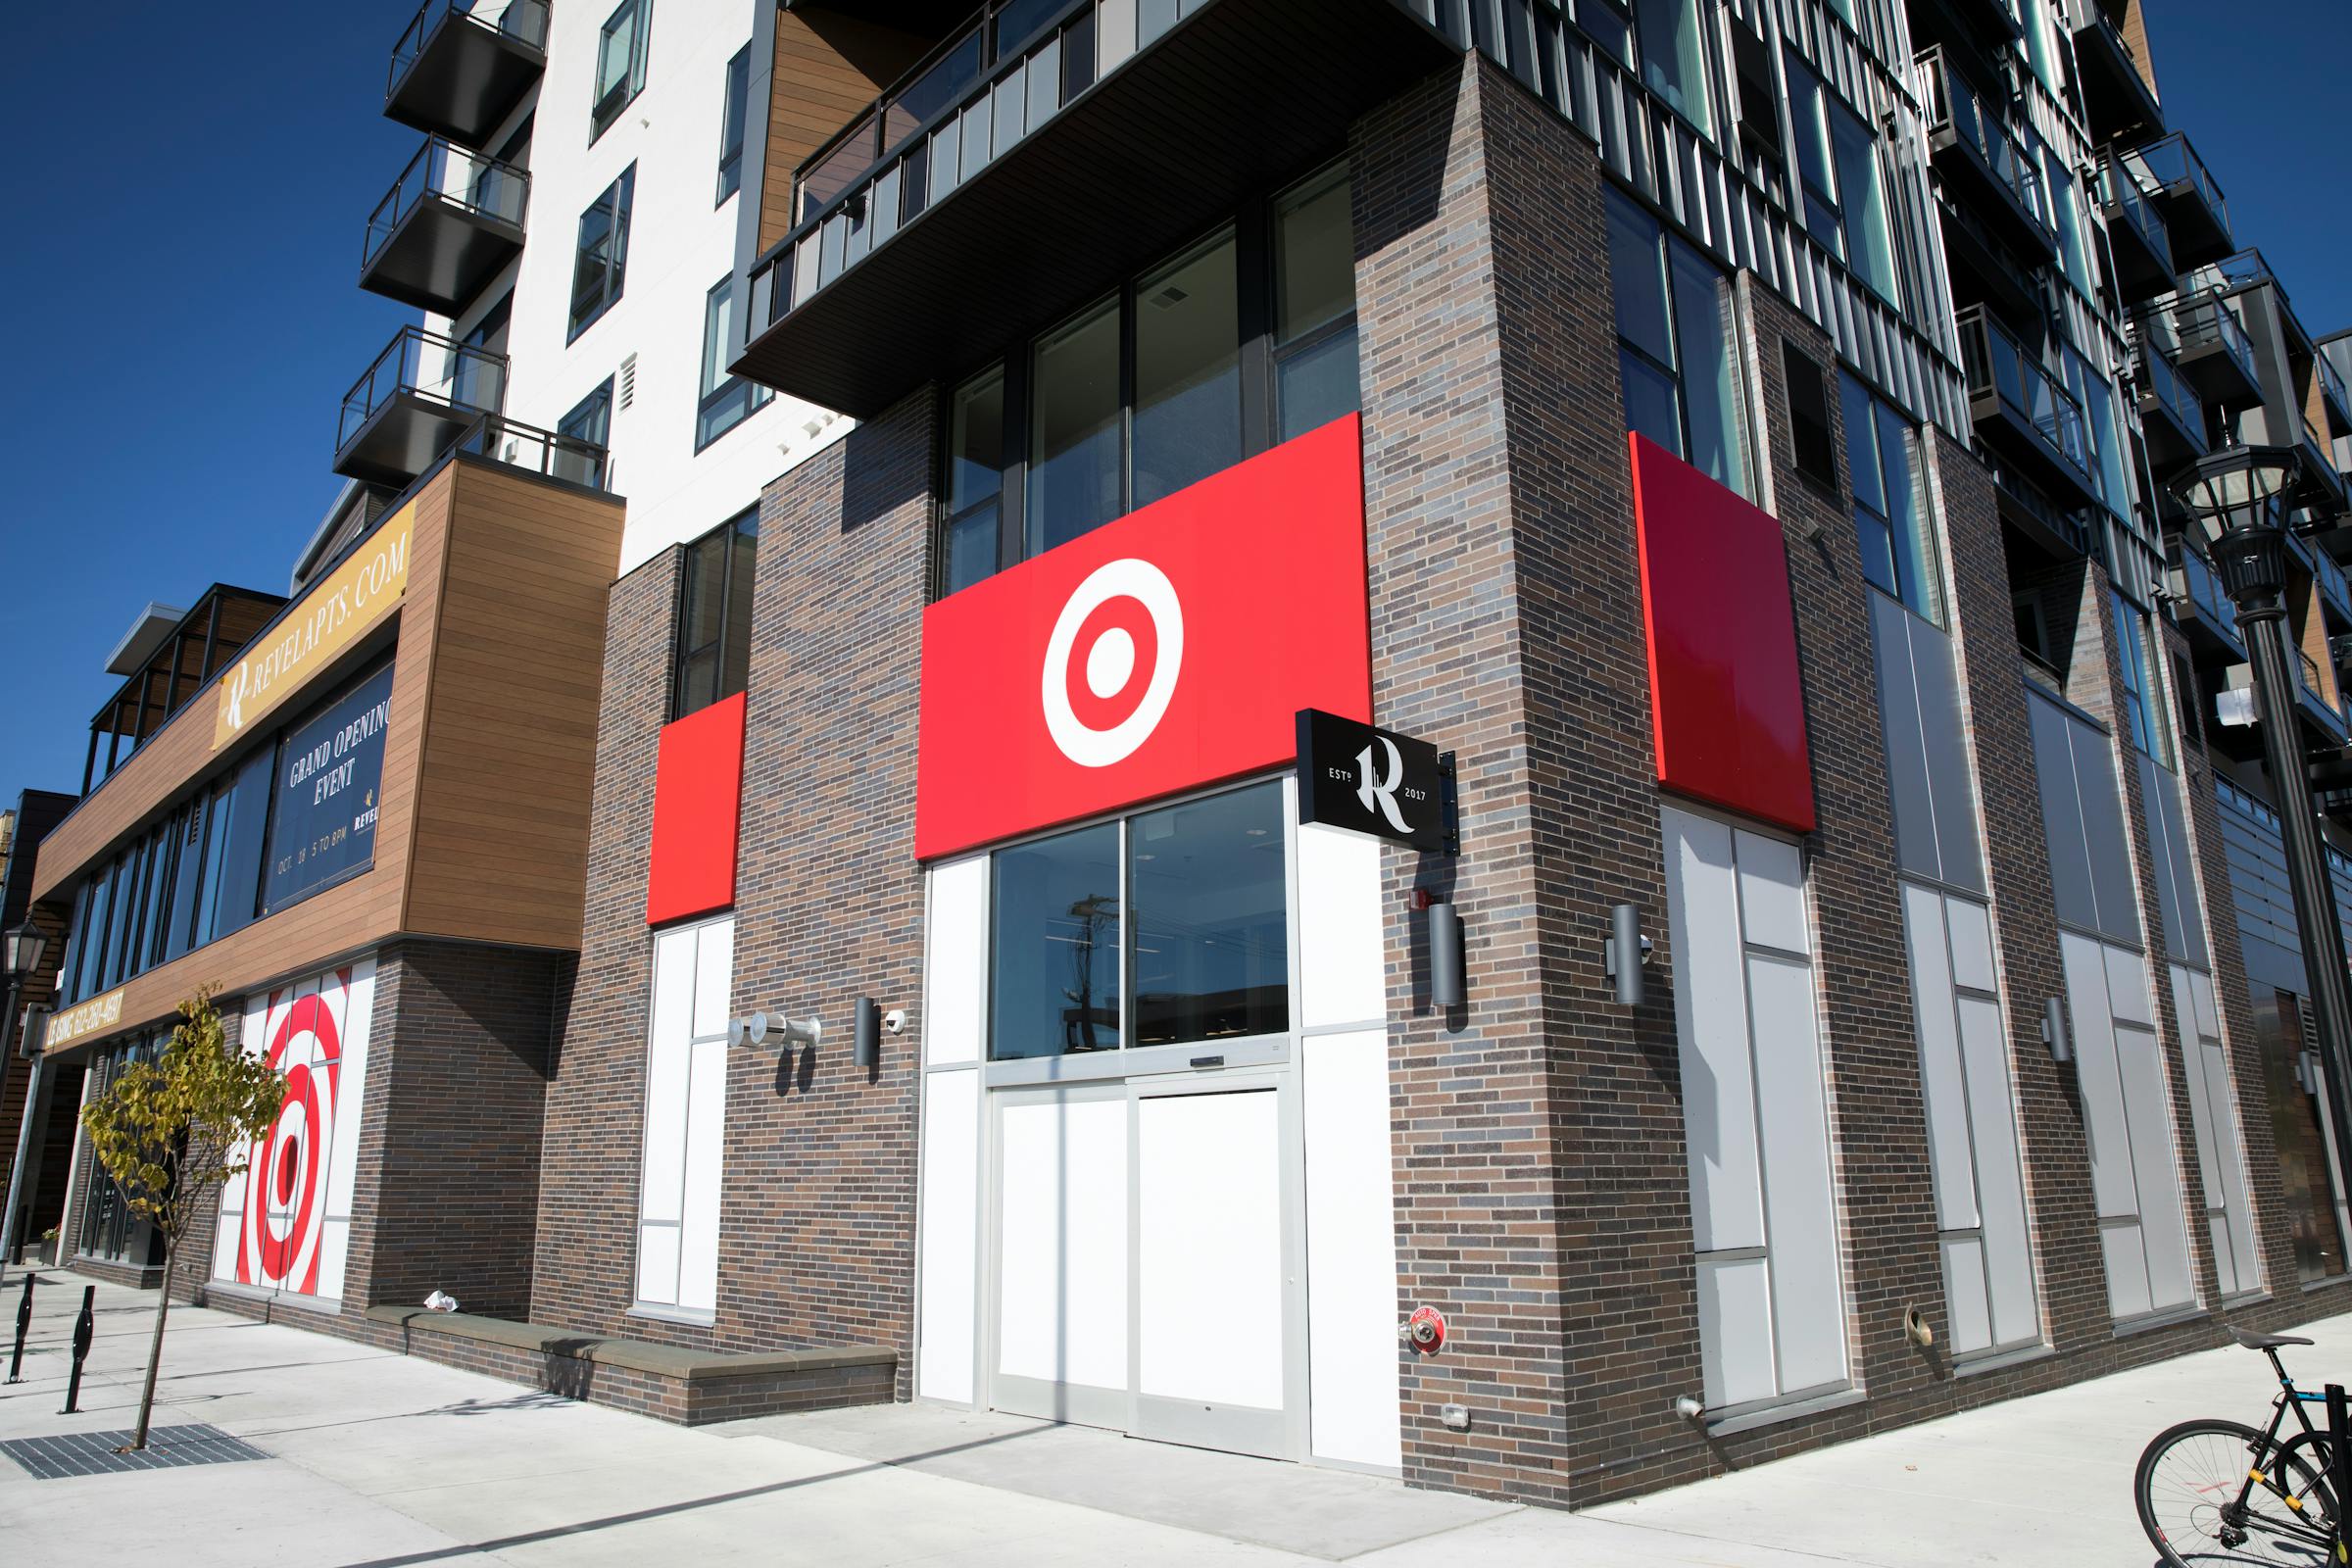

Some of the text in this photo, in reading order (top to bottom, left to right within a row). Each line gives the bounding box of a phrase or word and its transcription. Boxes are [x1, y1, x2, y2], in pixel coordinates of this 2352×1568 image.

[251, 532, 407, 699] REVELAPTS.COM
[290, 741, 330, 788] GRAND
[314, 758, 355, 806] EVENT
[1354, 735, 1416, 834] R
[1404, 787, 1426, 802] 2017
[312, 842, 318, 857] 5
[319, 835, 330, 854] TO
